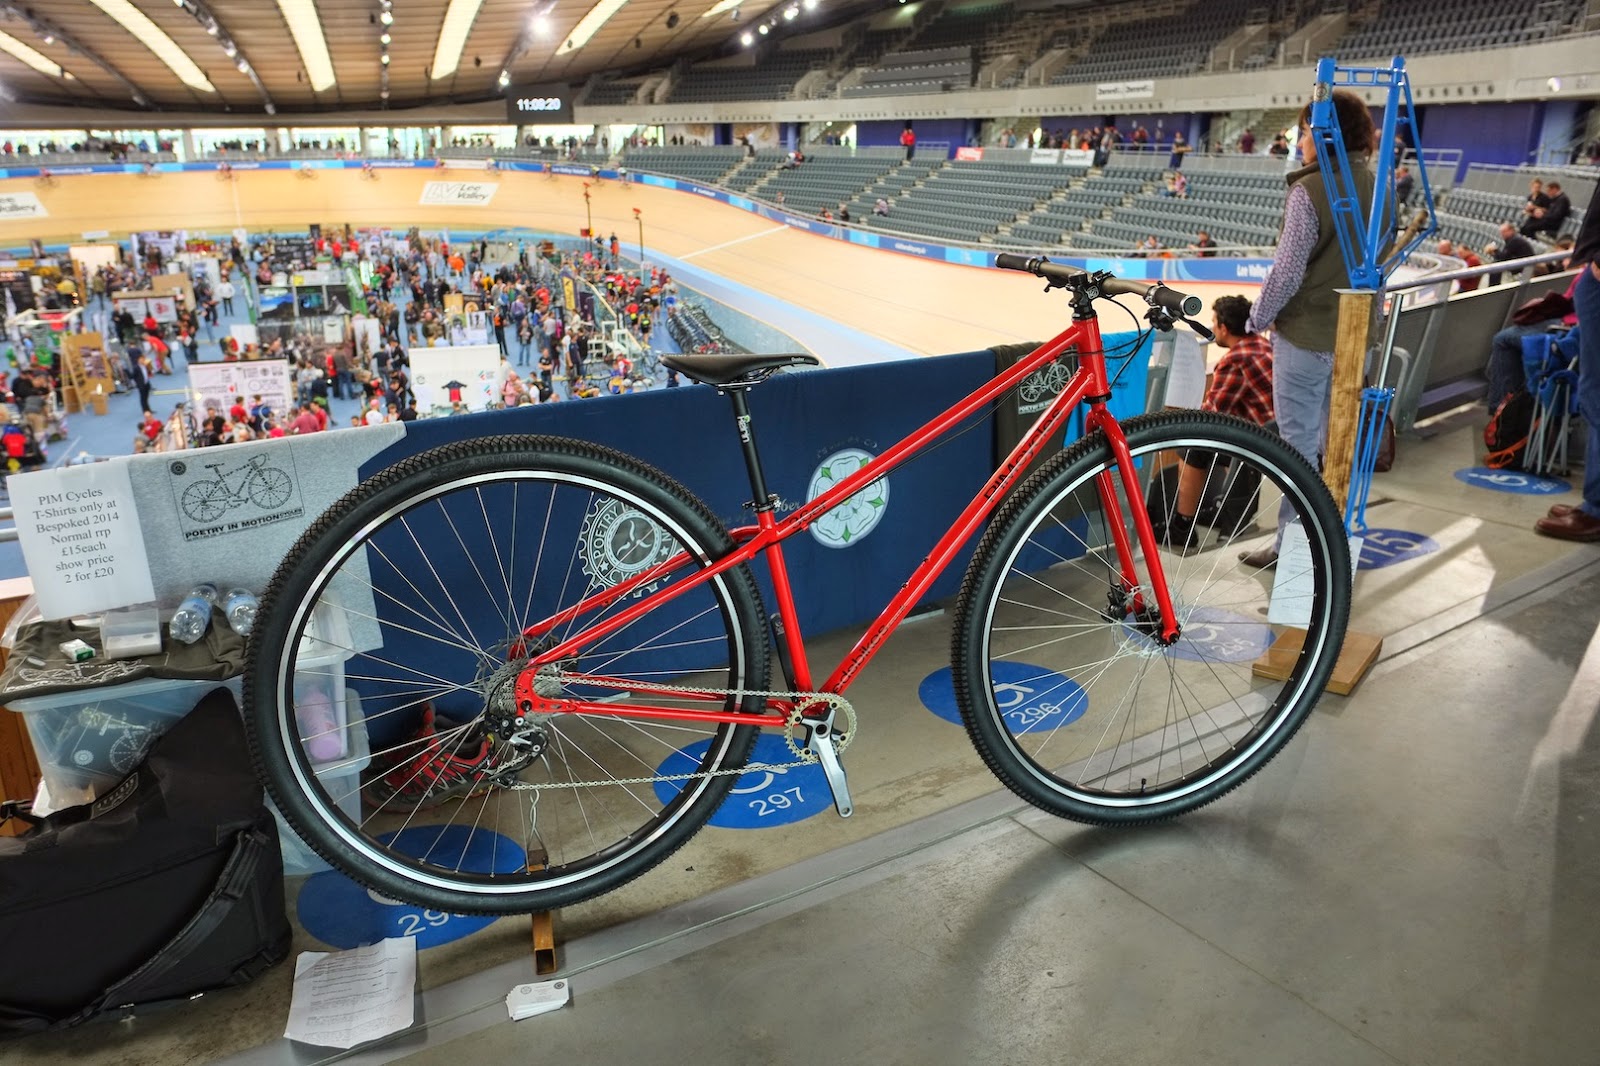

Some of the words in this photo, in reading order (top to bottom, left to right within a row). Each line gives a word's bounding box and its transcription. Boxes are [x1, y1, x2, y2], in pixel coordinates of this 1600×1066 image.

[38, 493, 63, 506] PIM
[65, 488, 103, 502] Cycles
[33, 504, 77, 520] T-Shirts
[80, 501, 104, 513] only
[107, 499, 117, 509] at
[36, 517, 90, 534] Bespoked
[93, 511, 119, 525] 2014
[185, 526, 225, 540] POETRY
[228, 523, 239, 531] IN
[241, 514, 279, 528] MOTION
[593, 505, 619, 560] POETRY
[50, 530, 92, 545] Normal
[95, 528, 111, 539] rrp
[61, 541, 107, 557] £15each
[55, 559, 83, 572] show
[87, 554, 115, 568] price
[65, 574, 72, 584] 2
[75, 571, 91, 582] for
[94, 567, 115, 579] £20
[1010, 702, 1062, 725] 296
[749, 786, 805, 817] 297
[397, 908, 468, 937] 29
